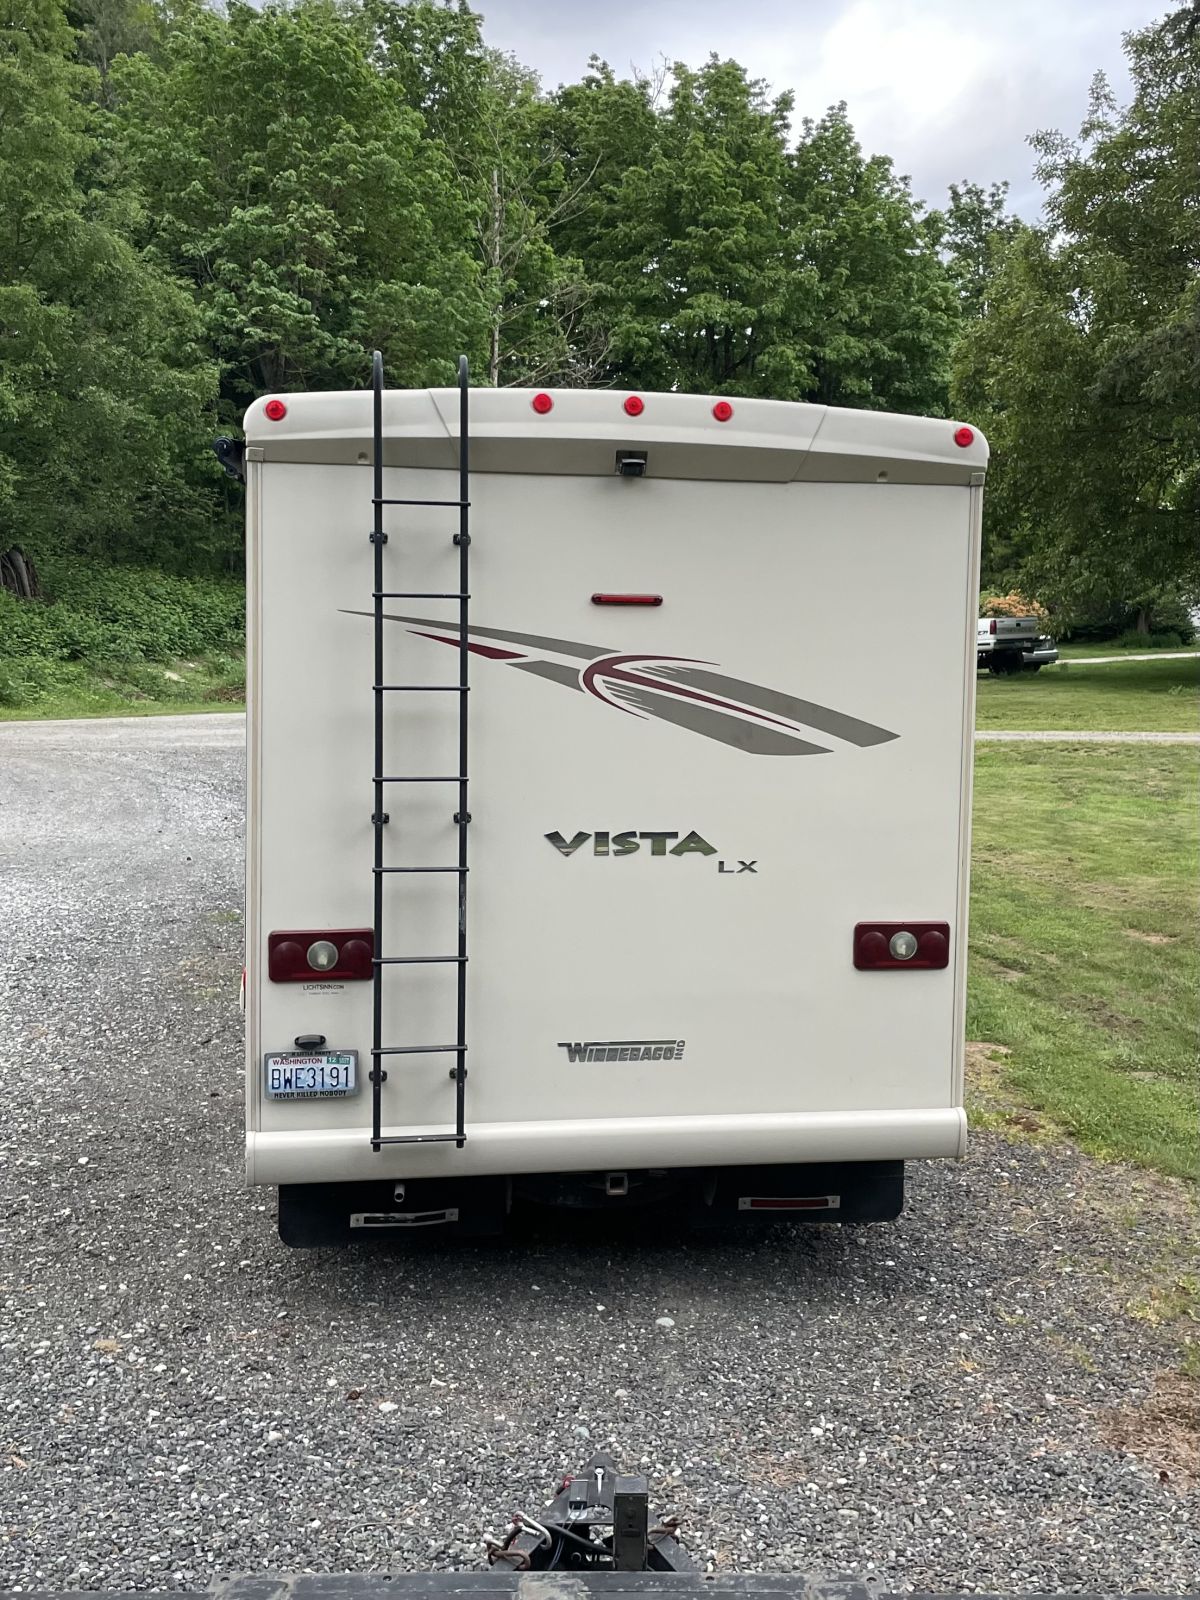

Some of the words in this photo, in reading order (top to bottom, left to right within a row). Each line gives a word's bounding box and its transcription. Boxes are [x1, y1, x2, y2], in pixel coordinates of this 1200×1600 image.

[544, 830, 718, 857] VISTA
[718, 861, 758, 873] LX
[557, 1040, 676, 1062] WINNEBAGO
[271, 1067, 349, 1090] BWE3191
